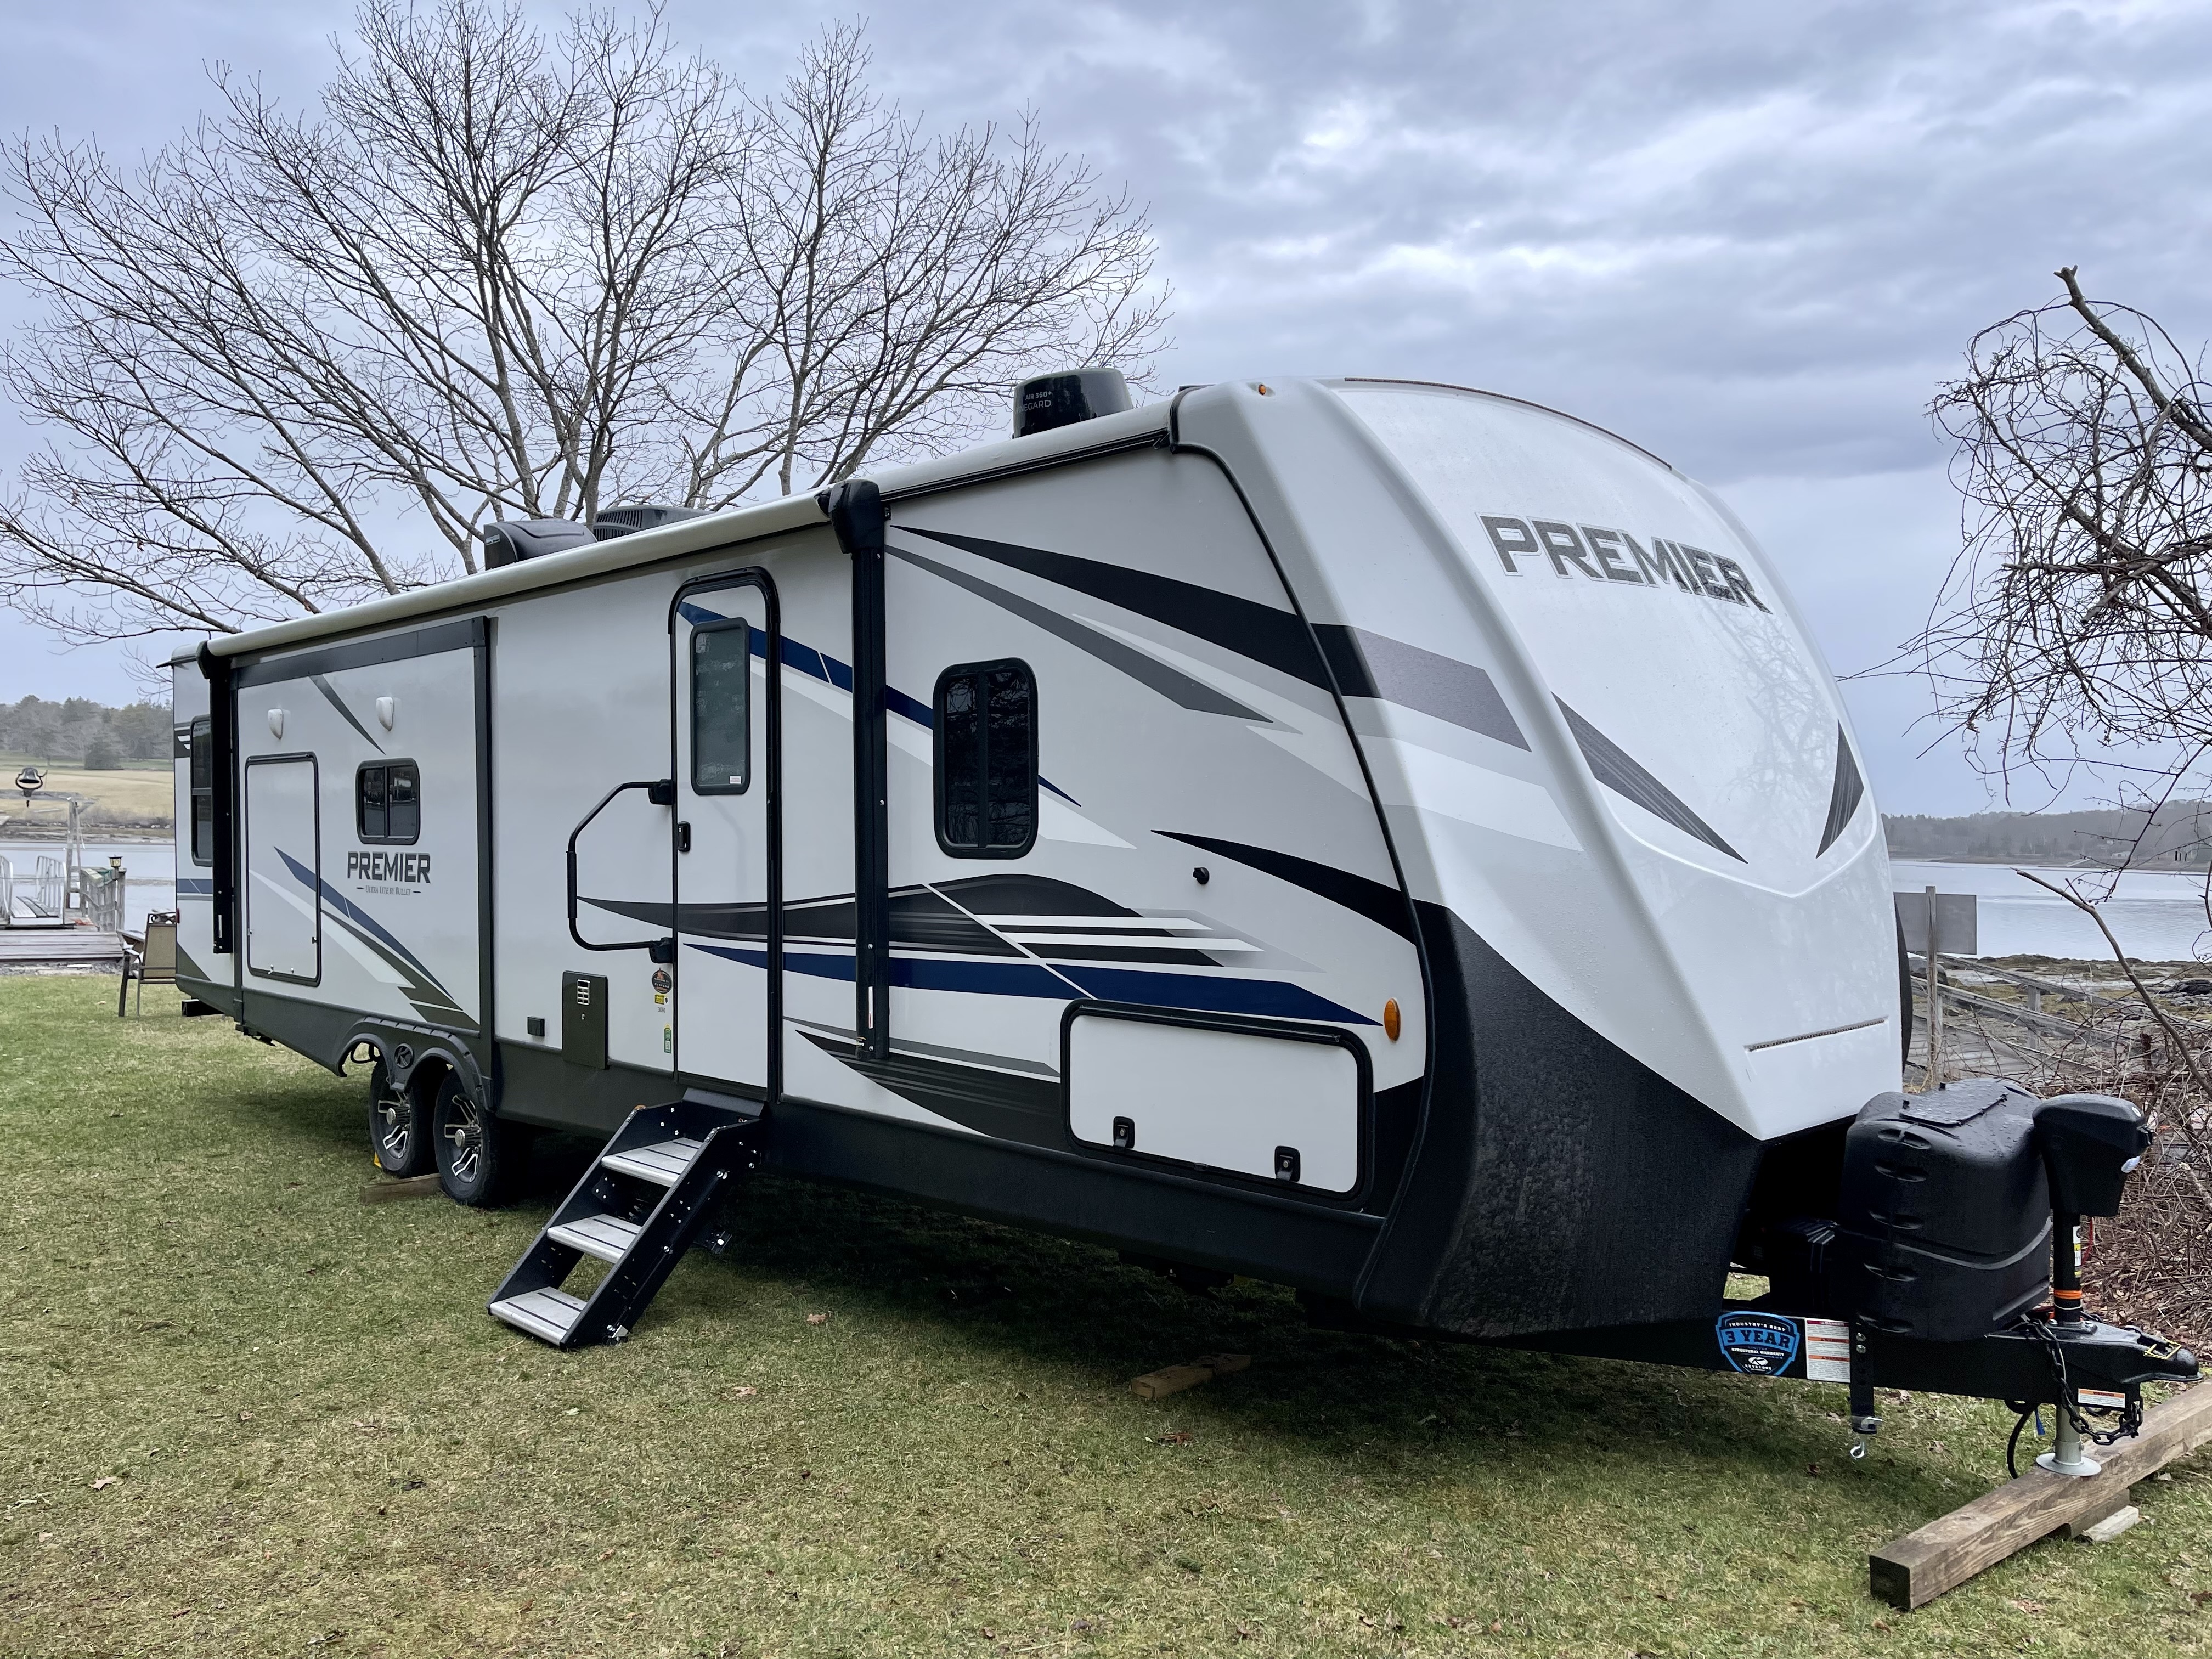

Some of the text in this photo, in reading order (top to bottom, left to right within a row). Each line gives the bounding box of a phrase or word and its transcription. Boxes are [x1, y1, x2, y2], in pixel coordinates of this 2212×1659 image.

[1476, 512, 1773, 614] PREMIER
[347, 851, 431, 883] PREMIER
[365, 885, 379, 894] ULTRA
[380, 885, 388, 894] LITE
[396, 887, 411, 896] BULLET
[1725, 1330, 1736, 1344] 3
[1740, 1329, 1791, 1349] YEAR
